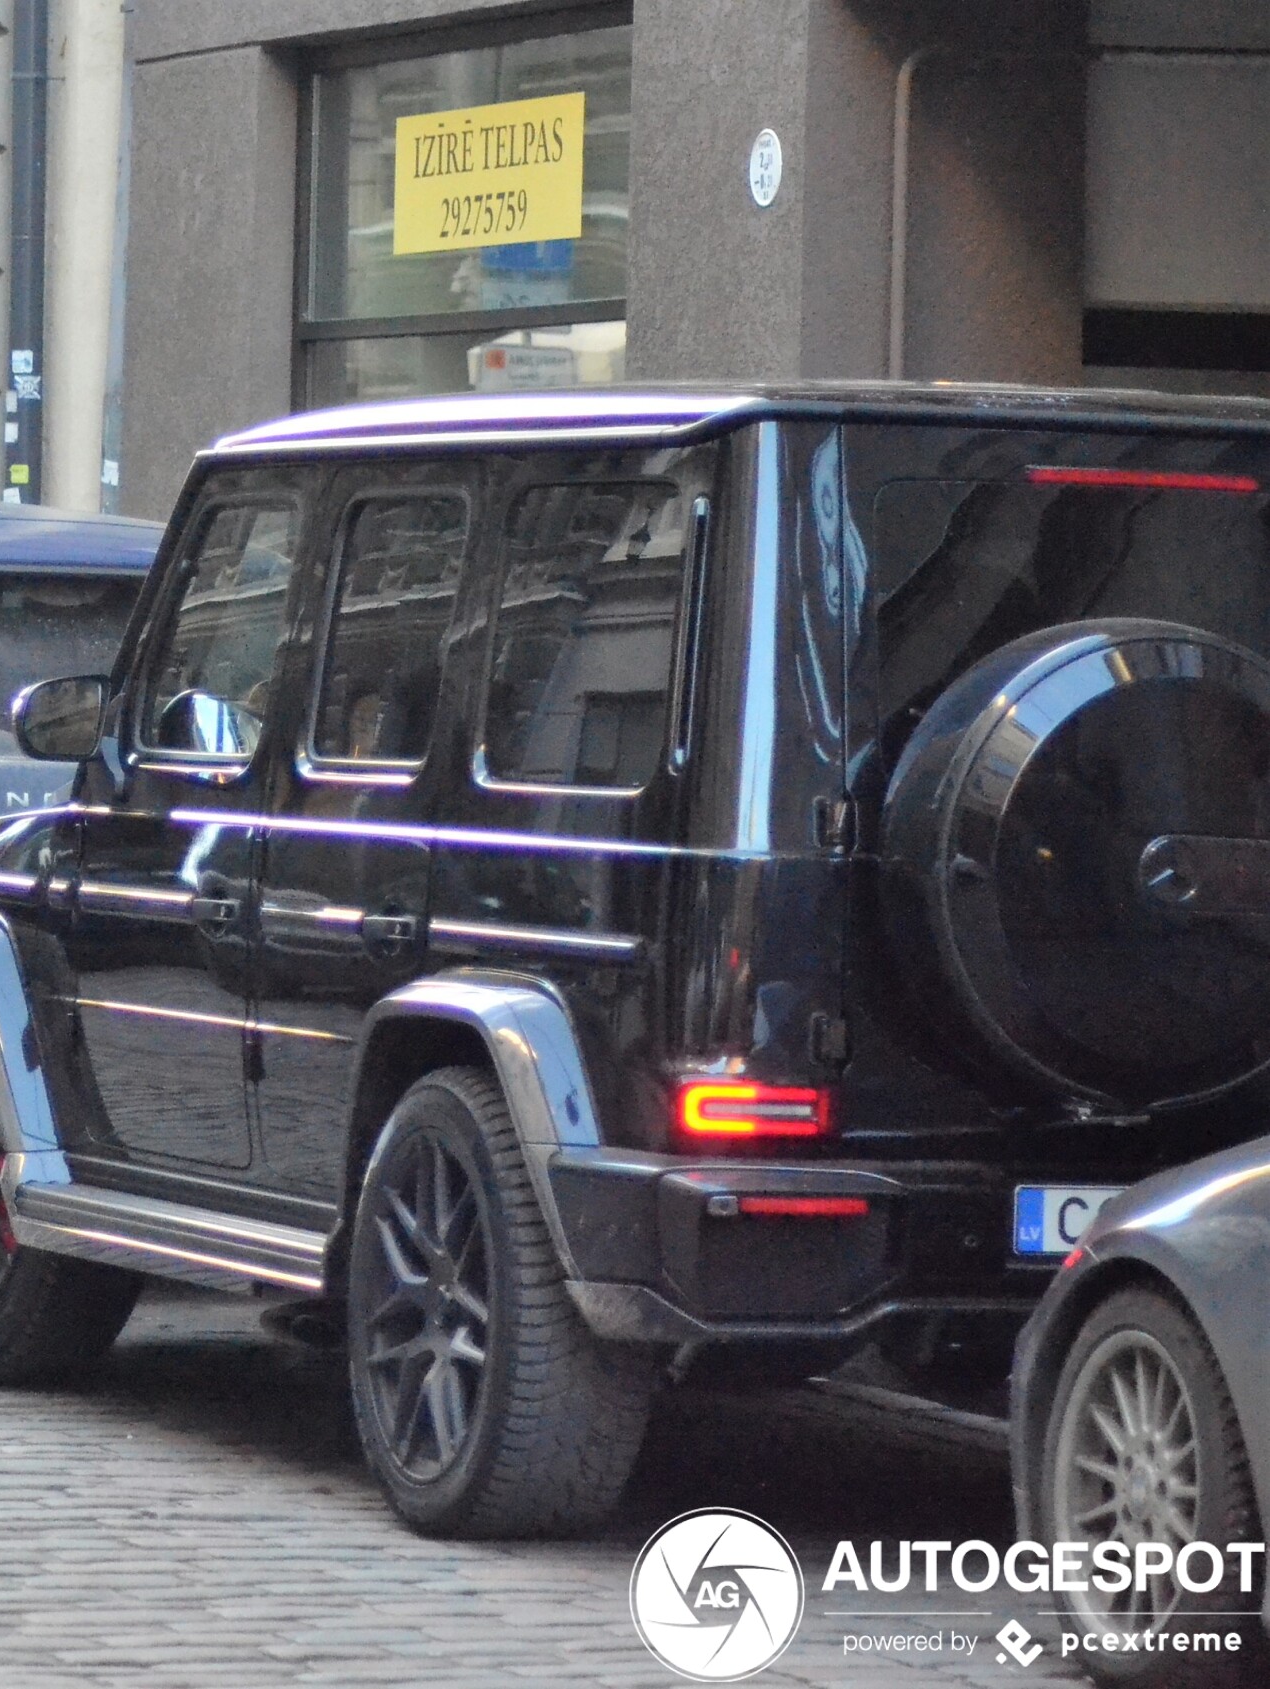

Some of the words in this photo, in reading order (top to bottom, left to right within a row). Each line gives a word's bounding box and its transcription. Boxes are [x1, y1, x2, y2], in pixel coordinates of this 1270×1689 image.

[413, 119, 474, 179] IZĪRĒ
[480, 117, 563, 171] TELPAS
[439, 188, 528, 239] 29275759
[1019, 1226, 1041, 1240] LV
